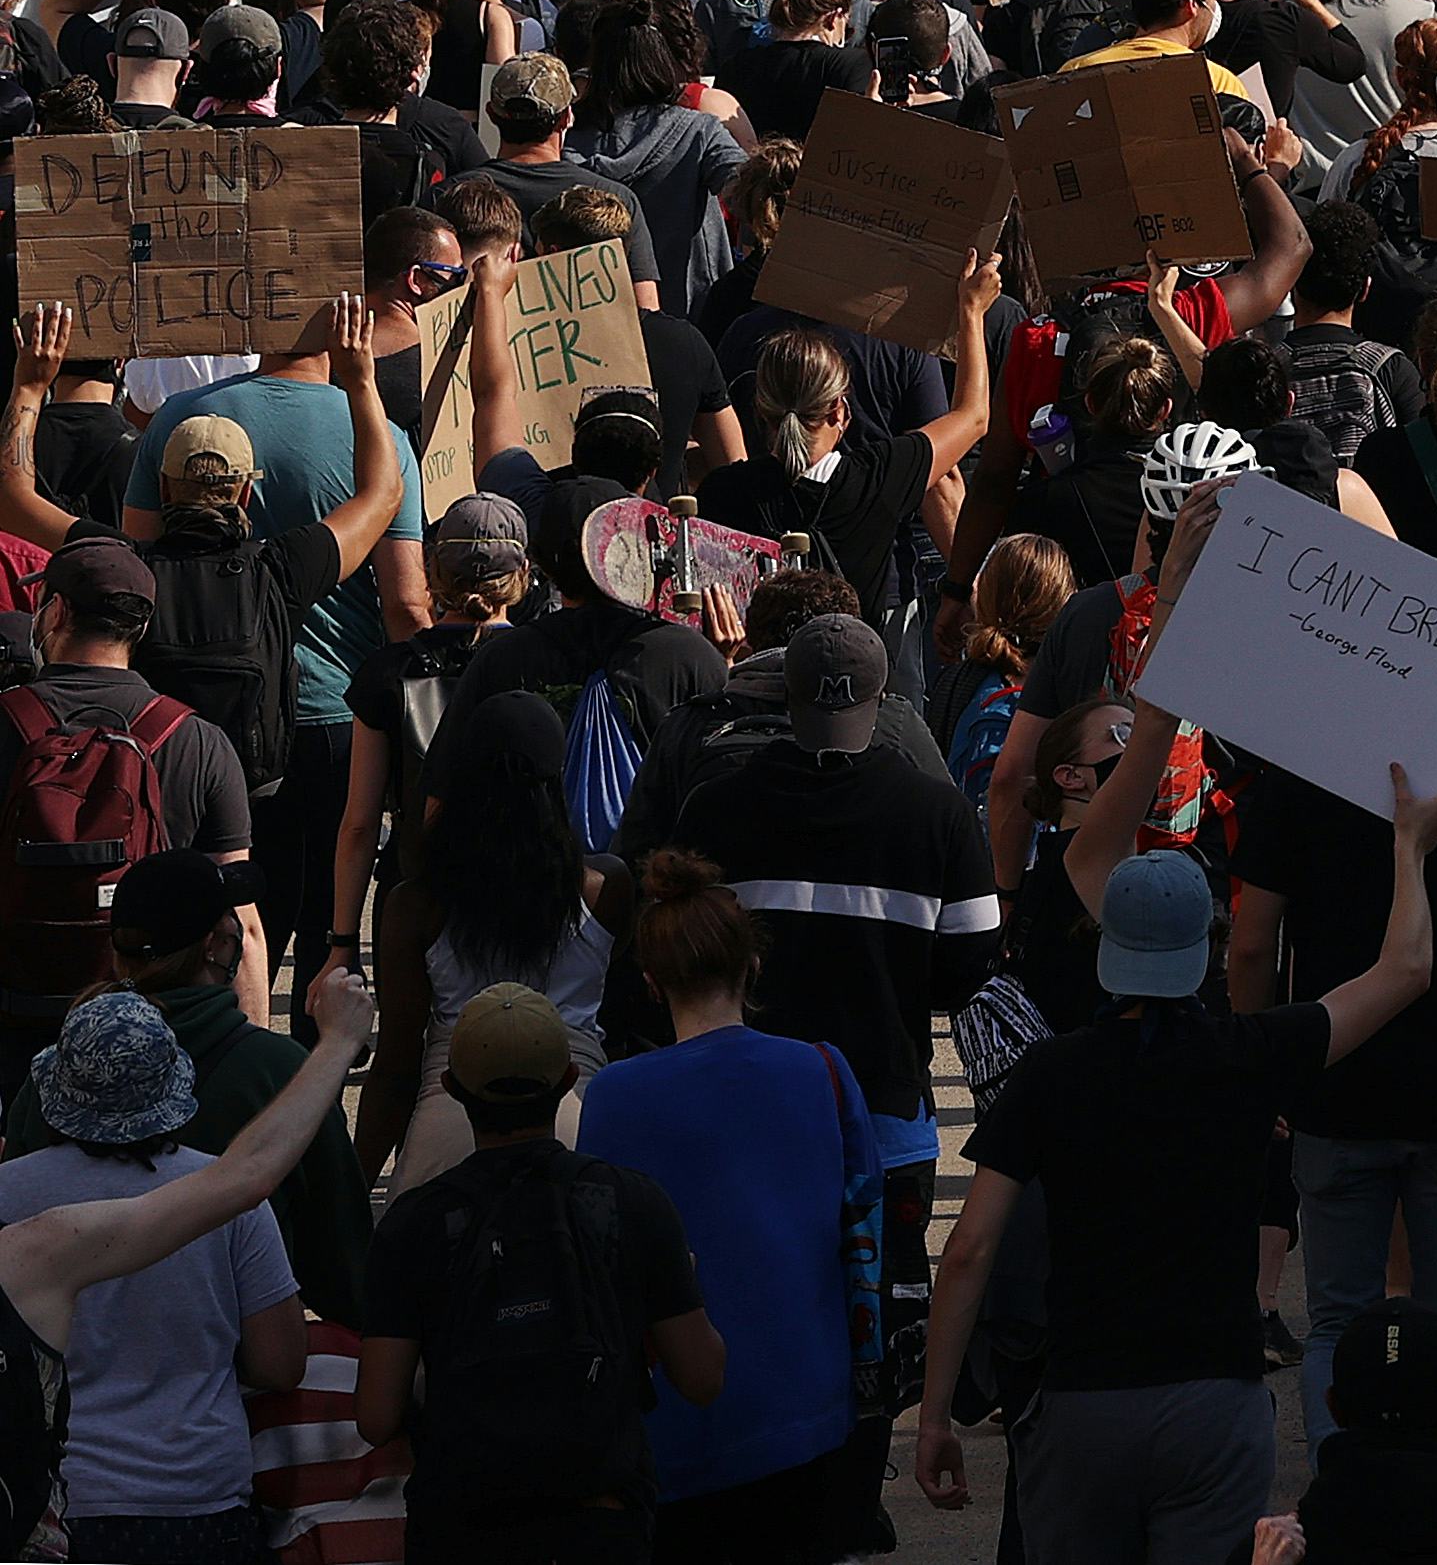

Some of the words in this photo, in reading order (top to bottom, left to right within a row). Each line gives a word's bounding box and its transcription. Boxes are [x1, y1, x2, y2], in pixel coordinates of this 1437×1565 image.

[41, 140, 284, 215] DEFUND
[152, 200, 219, 240] the
[75, 268, 300, 339] POLICE
[510, 243, 618, 315] LIVES
[1287, 547, 1392, 617] CANT
[814, 674, 856, 705] M
[1365, 646, 1415, 680] Floyd
